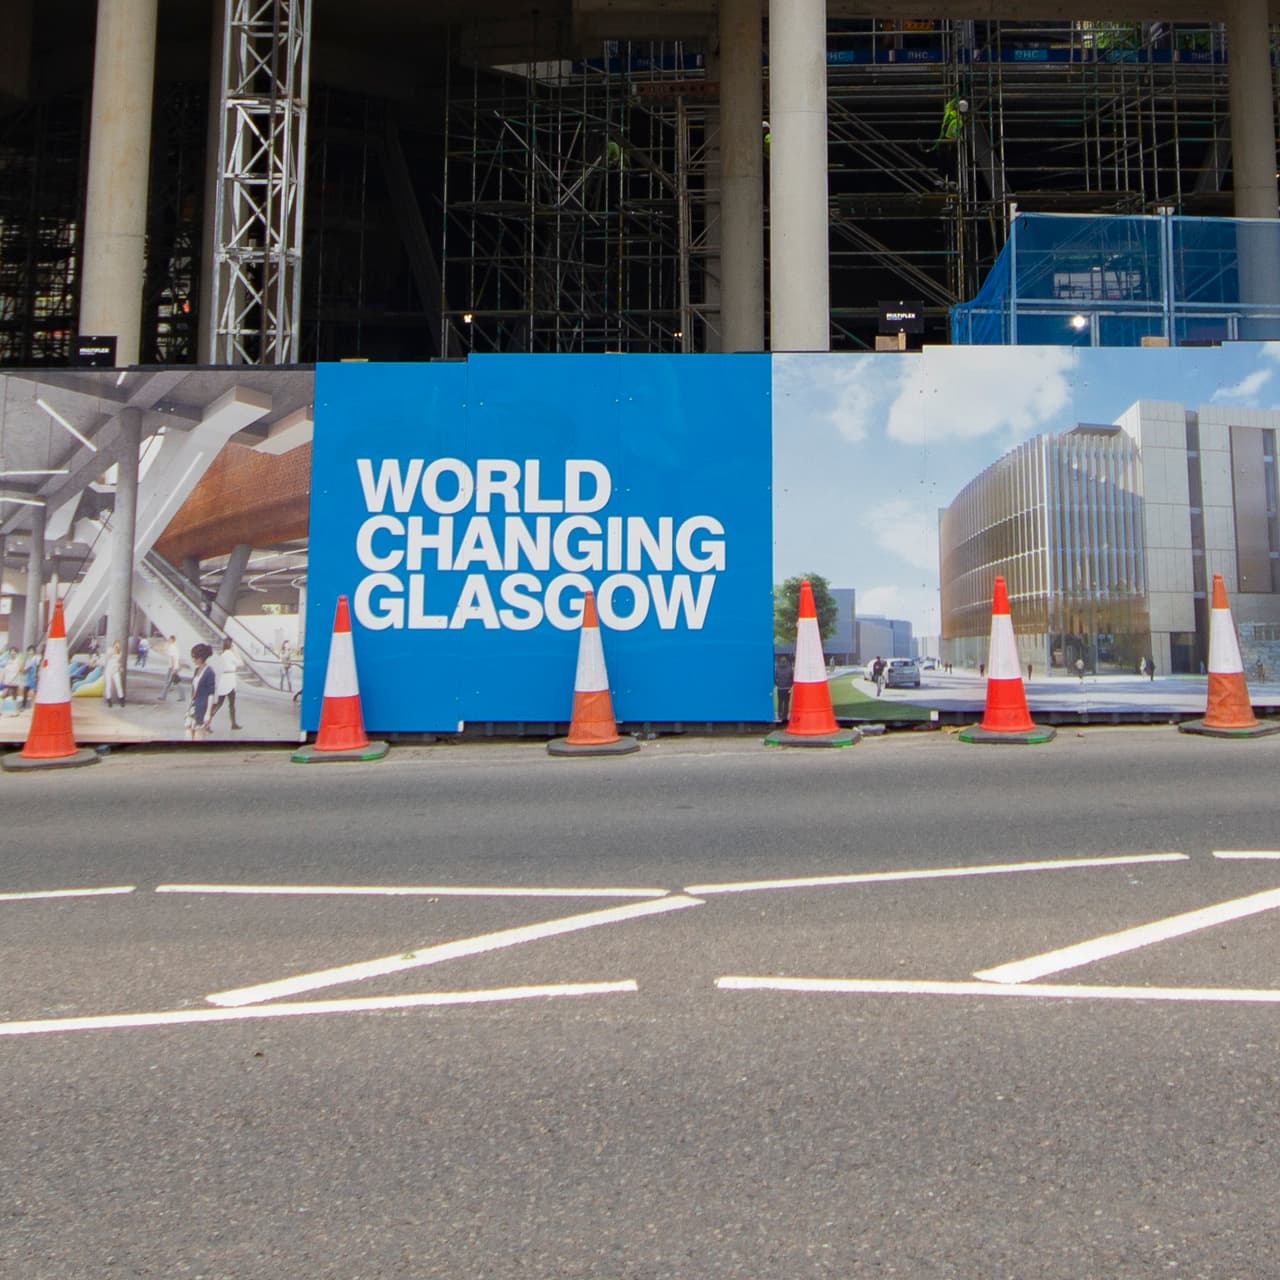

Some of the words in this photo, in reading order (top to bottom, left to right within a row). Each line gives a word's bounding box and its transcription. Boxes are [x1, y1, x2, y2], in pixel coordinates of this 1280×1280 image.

[356, 457, 612, 514] WORLD
[355, 514, 726, 573] CHANGING
[353, 572, 717, 631] GLASGOW
